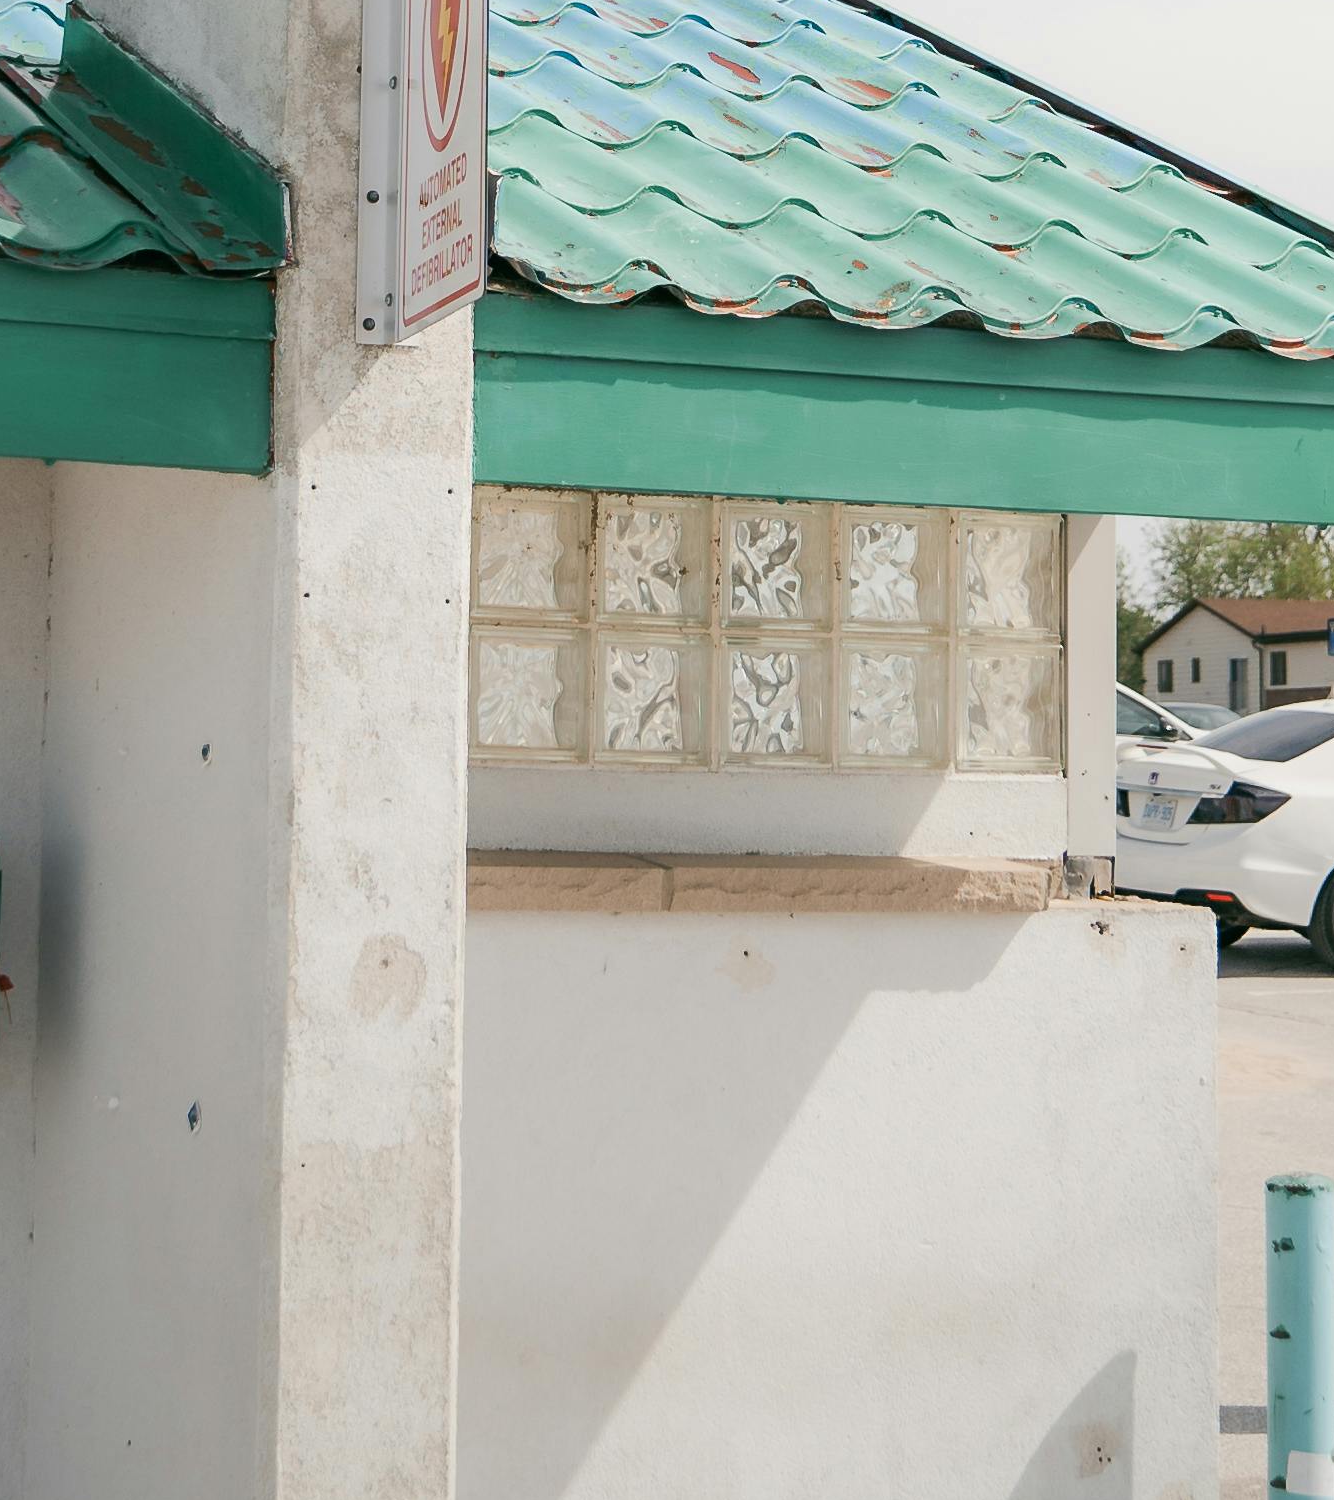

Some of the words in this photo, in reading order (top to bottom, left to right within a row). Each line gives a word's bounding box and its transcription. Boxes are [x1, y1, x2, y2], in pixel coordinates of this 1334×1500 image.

[419, 152, 467, 211] AUTOMATED
[422, 198, 463, 250] EXTERNAL
[411, 234, 473, 296] DEFIBRILLATOR
